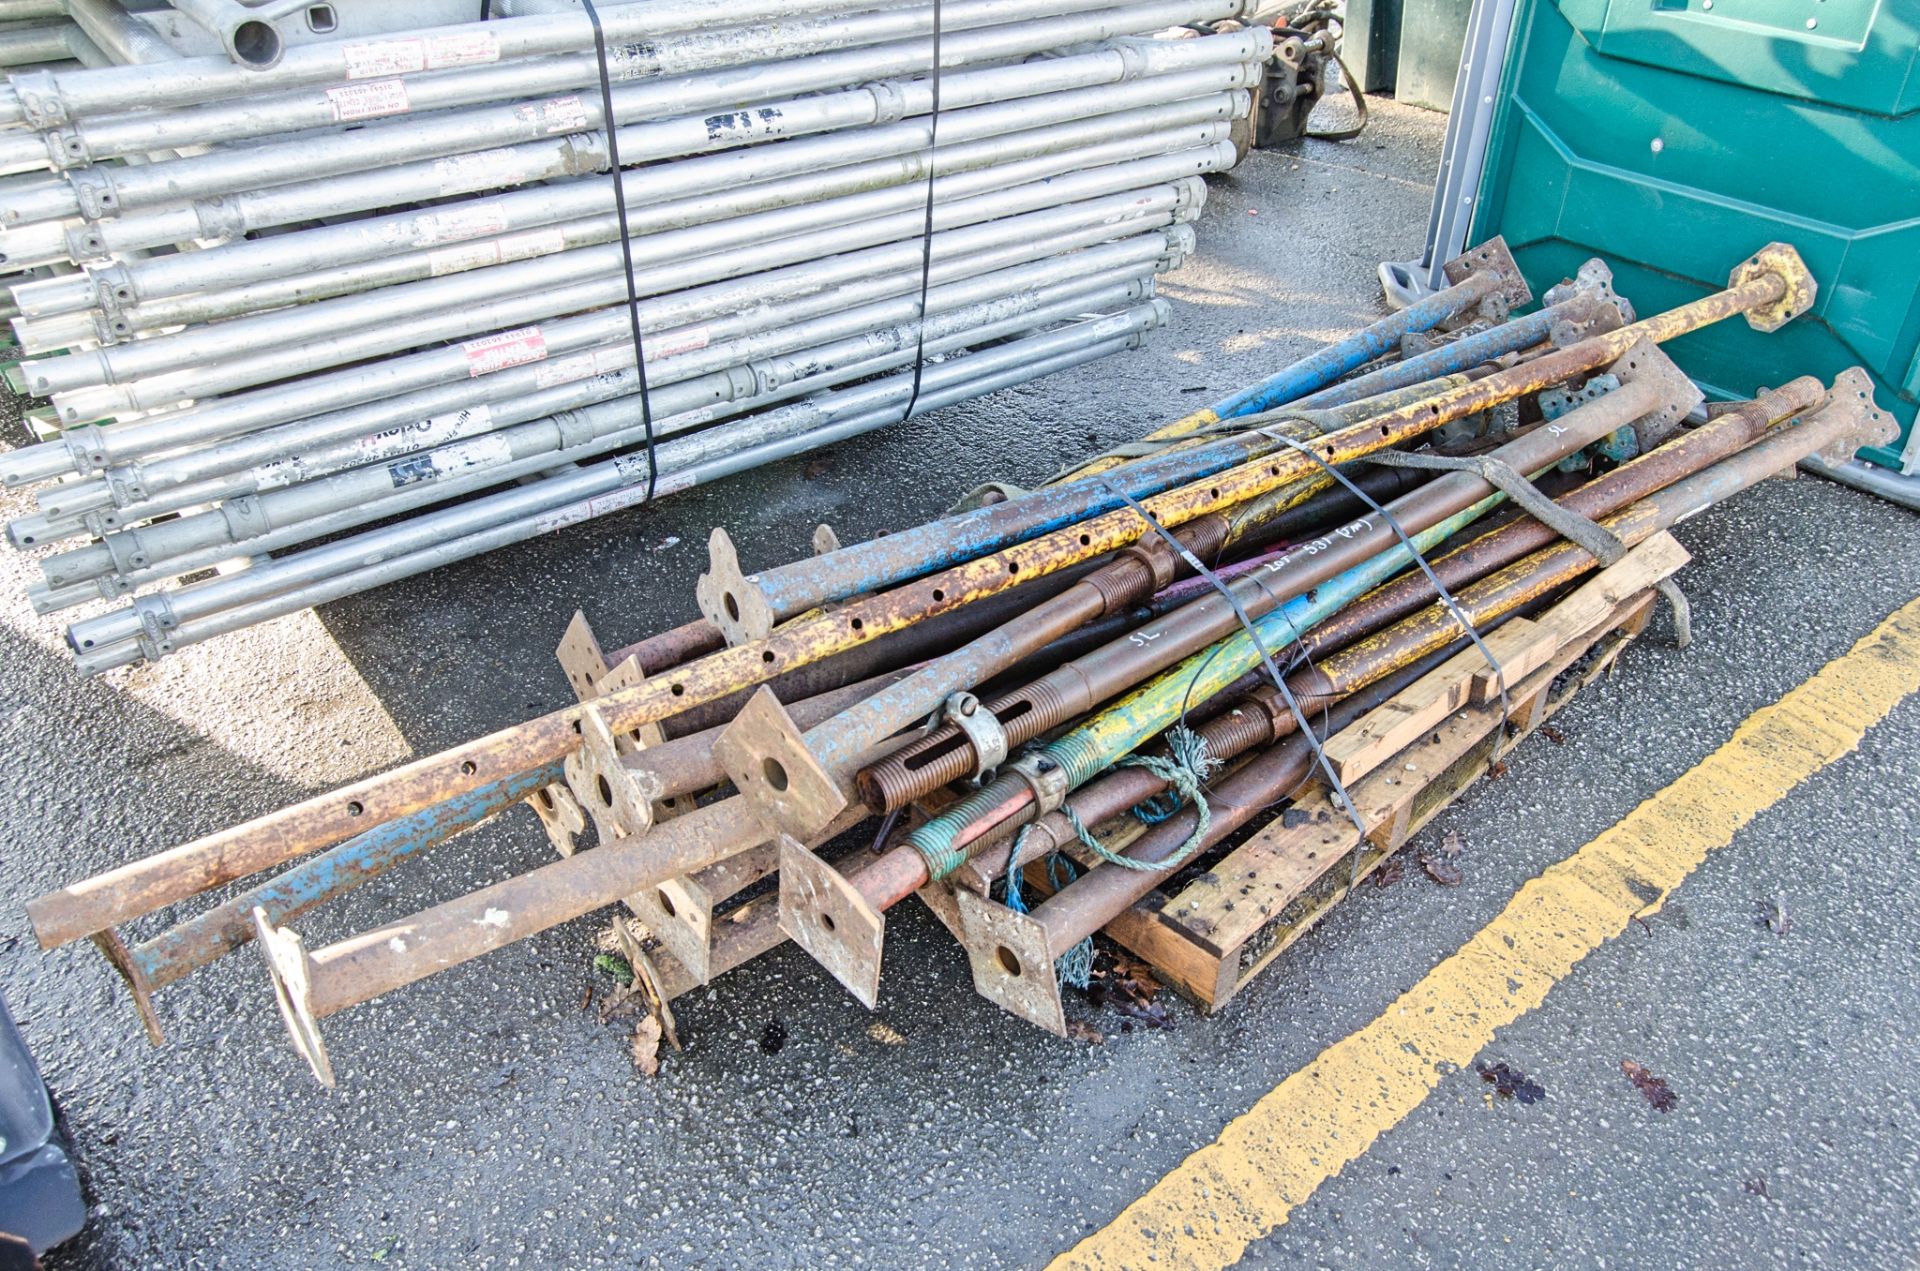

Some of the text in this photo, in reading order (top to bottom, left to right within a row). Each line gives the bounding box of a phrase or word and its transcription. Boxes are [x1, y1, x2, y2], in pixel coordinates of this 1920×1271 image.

[1264, 555, 1291, 572] LOT
[1303, 537, 1332, 555] 531
[1129, 632, 1160, 647] SL
